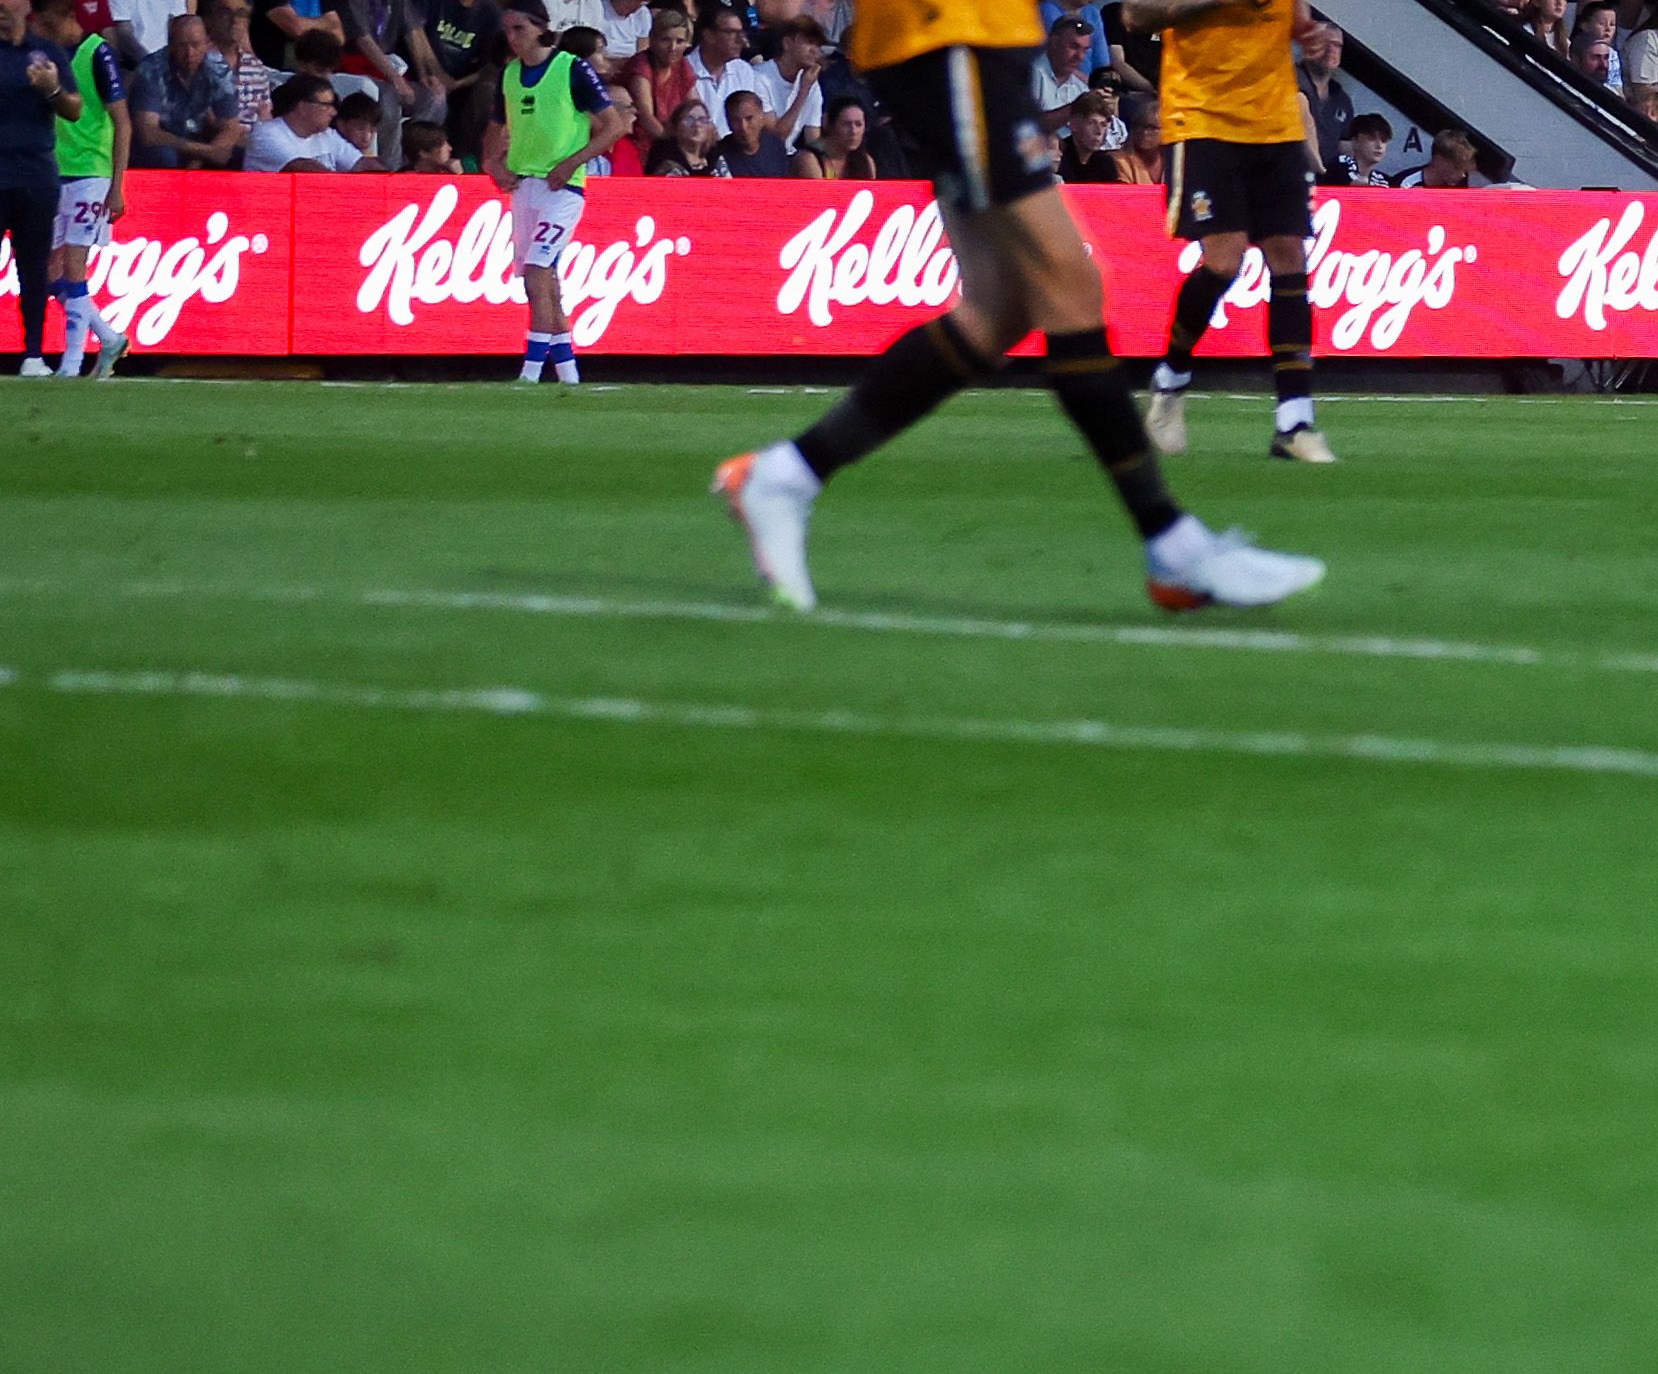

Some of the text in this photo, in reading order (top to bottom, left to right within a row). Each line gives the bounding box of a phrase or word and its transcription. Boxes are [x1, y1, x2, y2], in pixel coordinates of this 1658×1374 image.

[1403, 127, 1423, 153] A
[534, 221, 565, 244] 27
[356, 183, 674, 347] Kellgg's
